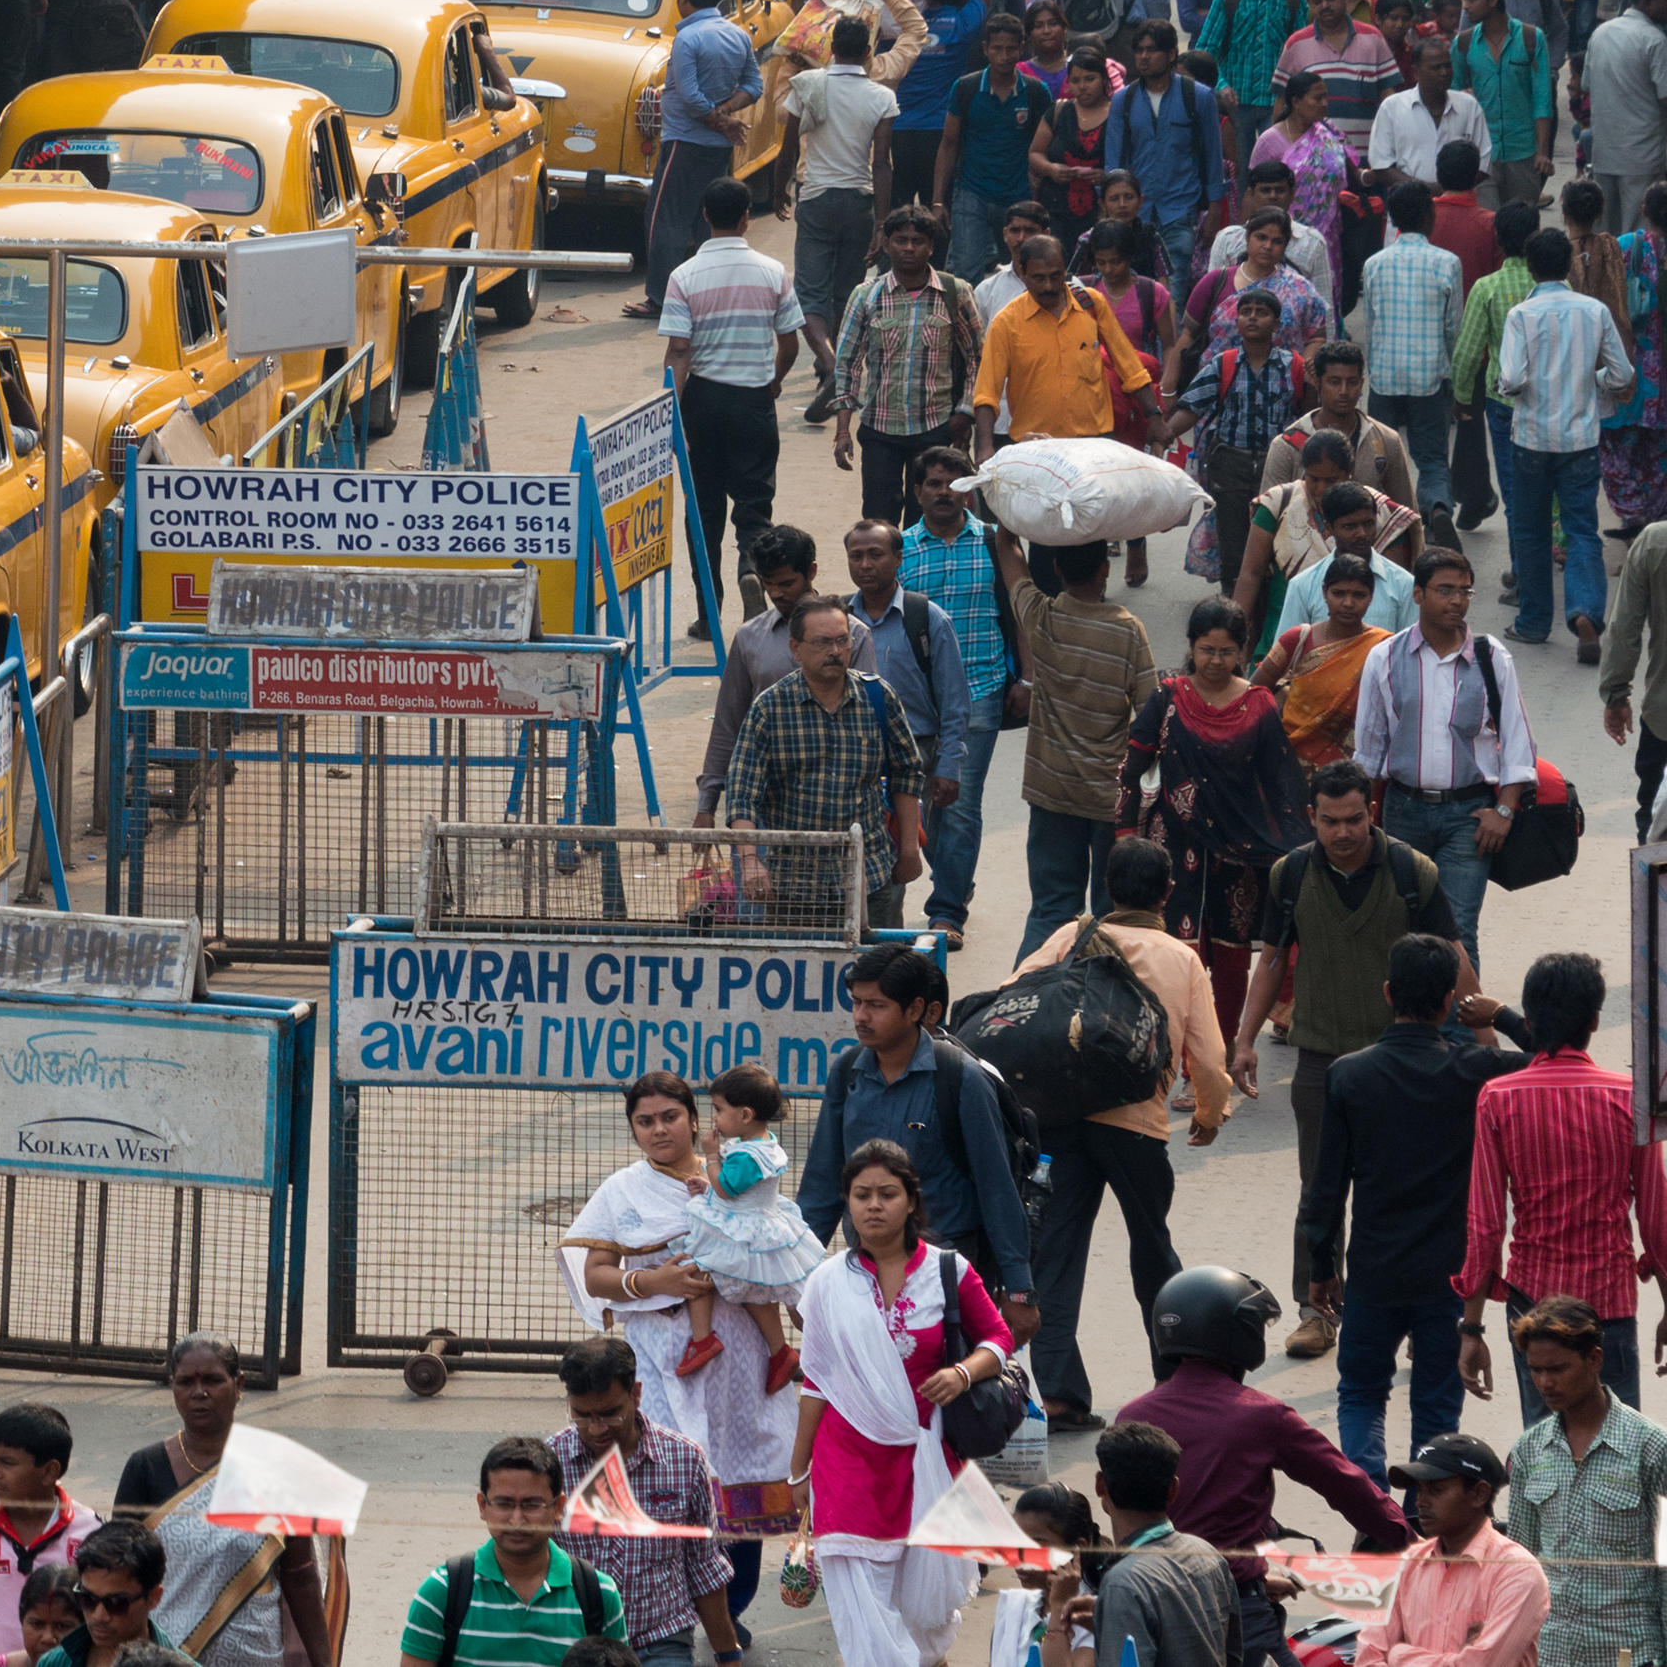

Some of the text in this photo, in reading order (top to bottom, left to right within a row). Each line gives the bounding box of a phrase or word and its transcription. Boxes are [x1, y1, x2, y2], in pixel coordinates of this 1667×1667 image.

[155, 57, 217, 69] TAXI
[11, 171, 76, 184] TAXI
[147, 475, 571, 507] HOWRAH CITY POLICE
[149, 509, 572, 533] CONTROL ROOM NO 033 2641 5614
[149, 531, 572, 555] GOLABARI P.S. NO 033 2666 3515
[218, 577, 521, 631] HOWRAH CITY POLICE
[140, 649, 236, 682] Jaquar
[257, 651, 452, 685] paulco distributors
[126, 686, 249, 704] experience bathing
[296, 693, 342, 707] Benaras
[345, 694, 378, 709] Road,
[381, 695, 437, 711] Belgachia,
[441, 696, 484, 710] Howrah
[62, 927, 181, 990] POLICE
[353, 946, 570, 1005] HOWRAH
[584, 952, 704, 1009] CITY
[359, 1014, 525, 1076] avani
[537, 1015, 762, 1082] riverside
[17, 1130, 111, 1161] KOLKATA
